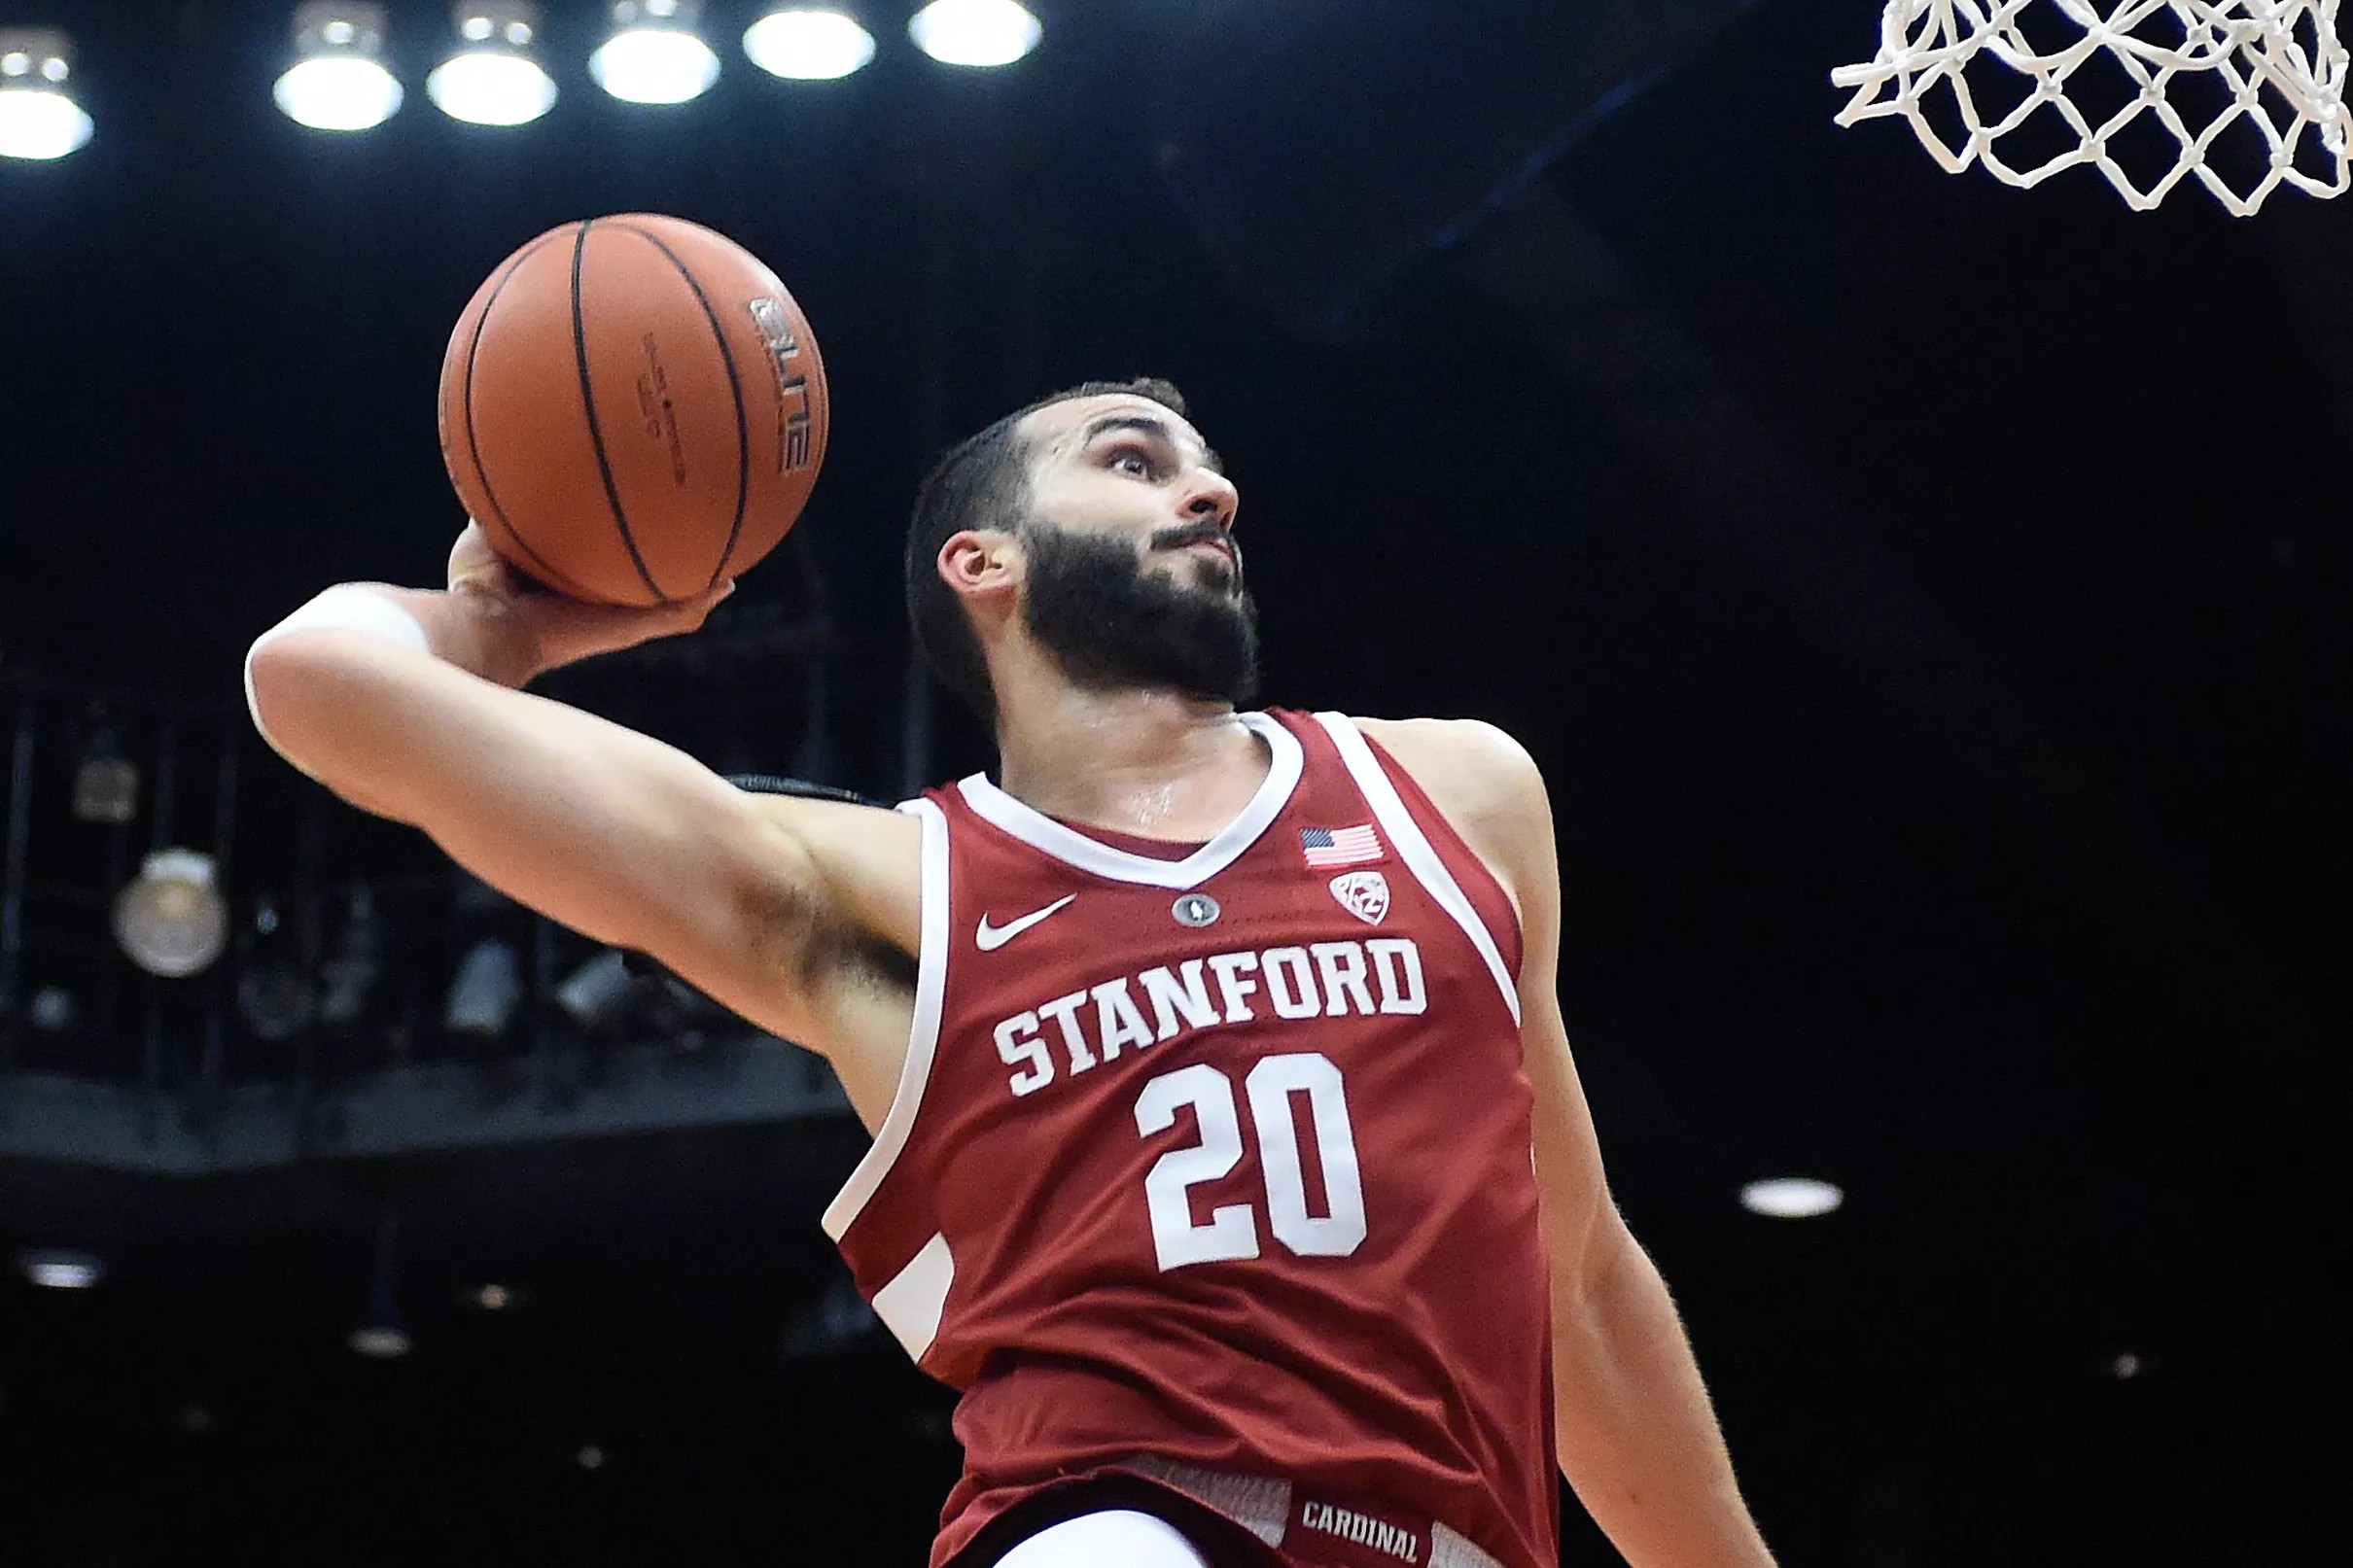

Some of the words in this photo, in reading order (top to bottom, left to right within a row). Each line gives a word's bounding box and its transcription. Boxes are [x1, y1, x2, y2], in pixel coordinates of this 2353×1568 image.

[993, 938, 1427, 1098] STANFORD
[1133, 1052, 1368, 1273] 20
[1302, 1500, 1418, 1564] CARDINAL
